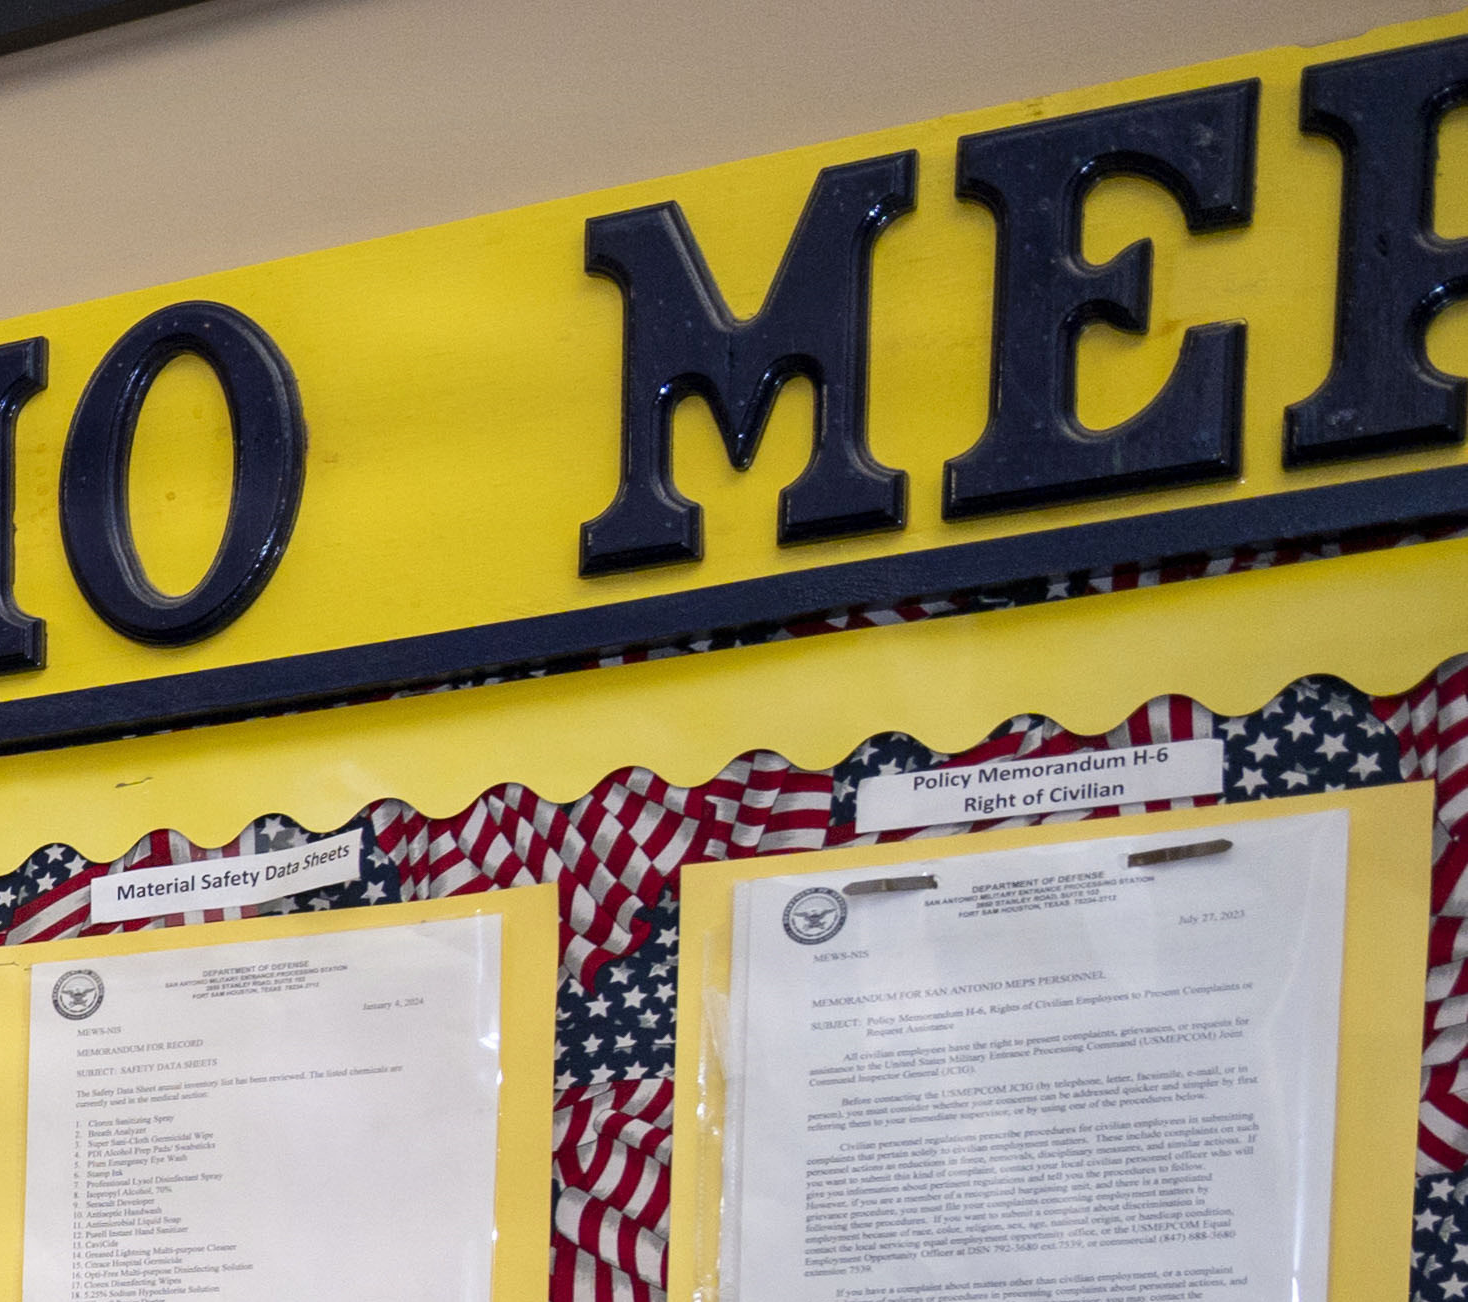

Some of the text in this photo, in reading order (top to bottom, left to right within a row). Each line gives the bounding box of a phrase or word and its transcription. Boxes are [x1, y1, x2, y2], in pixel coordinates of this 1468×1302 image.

[913, 748, 1169, 792] Policy Memorandum H-6
[964, 782, 1125, 814] Right of Civilian
[116, 843, 350, 901] Material Safety Data Sheets
